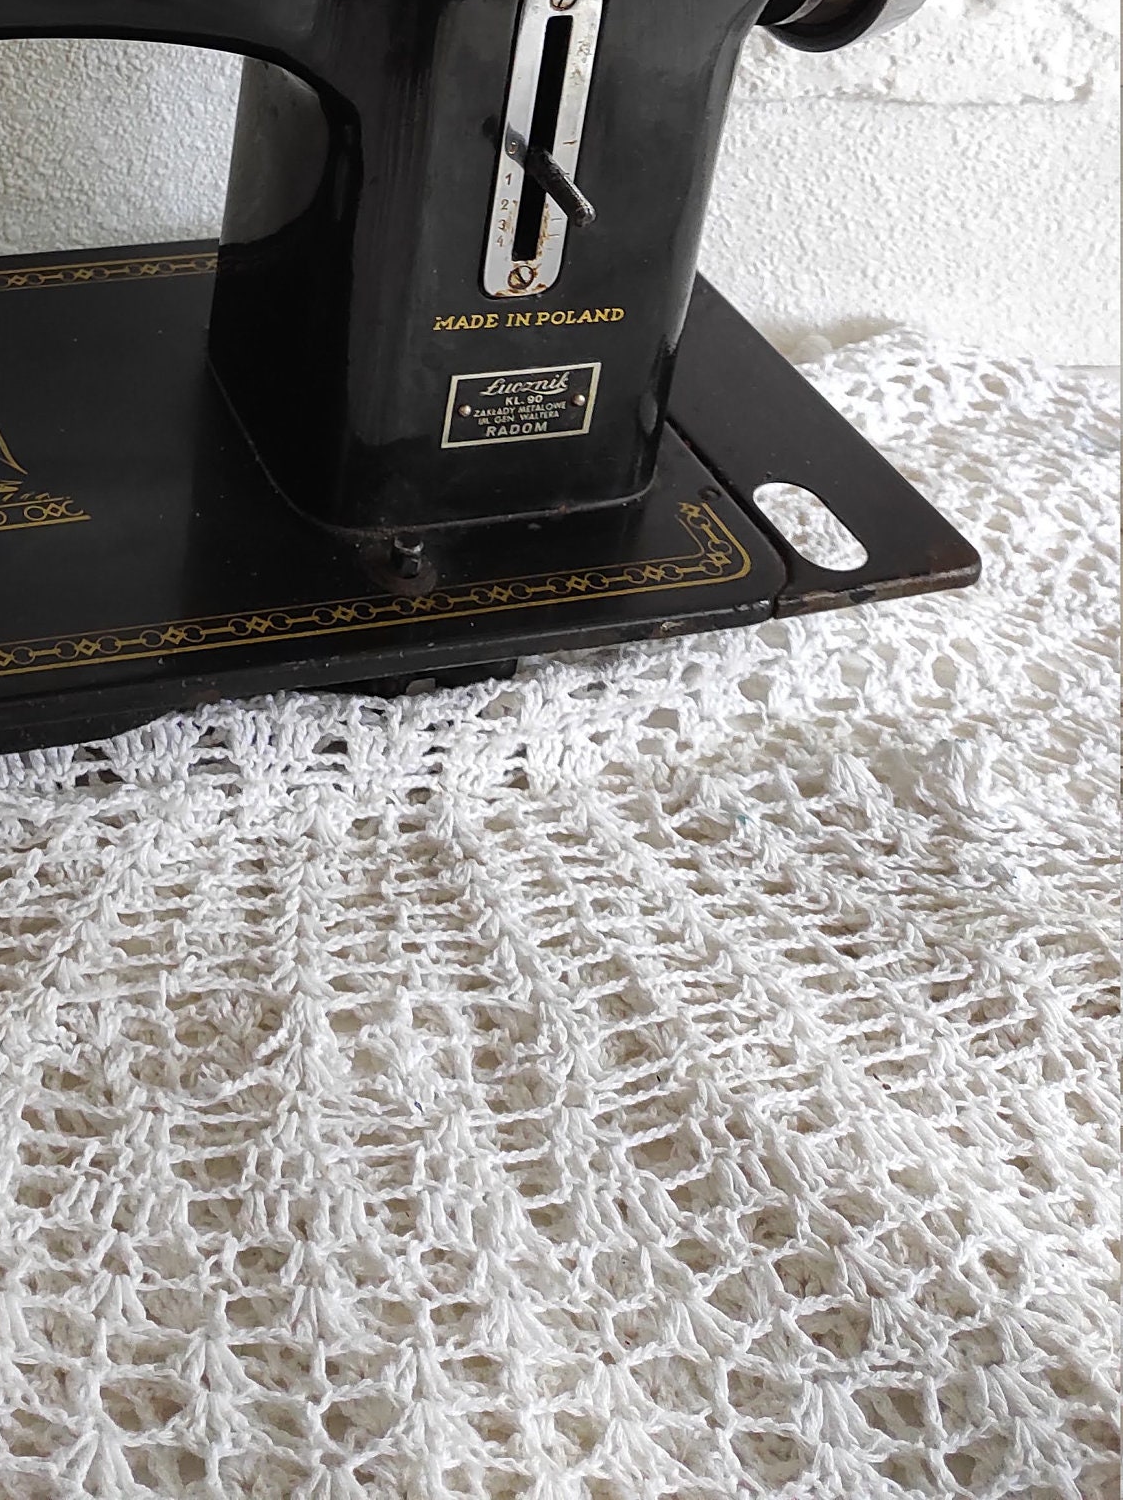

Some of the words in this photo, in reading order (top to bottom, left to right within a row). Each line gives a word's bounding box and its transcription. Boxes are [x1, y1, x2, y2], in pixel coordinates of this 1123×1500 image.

[505, 173, 513, 186] 1
[501, 199, 509, 211] 2
[498, 219, 506, 231] 3
[433, 313, 499, 331] MADE
[505, 312, 533, 328] IN
[535, 307, 625, 327] POLAND
[480, 371, 570, 396] Łucznik
[527, 395, 543, 405] 90
[486, 421, 548, 437] RADOM
